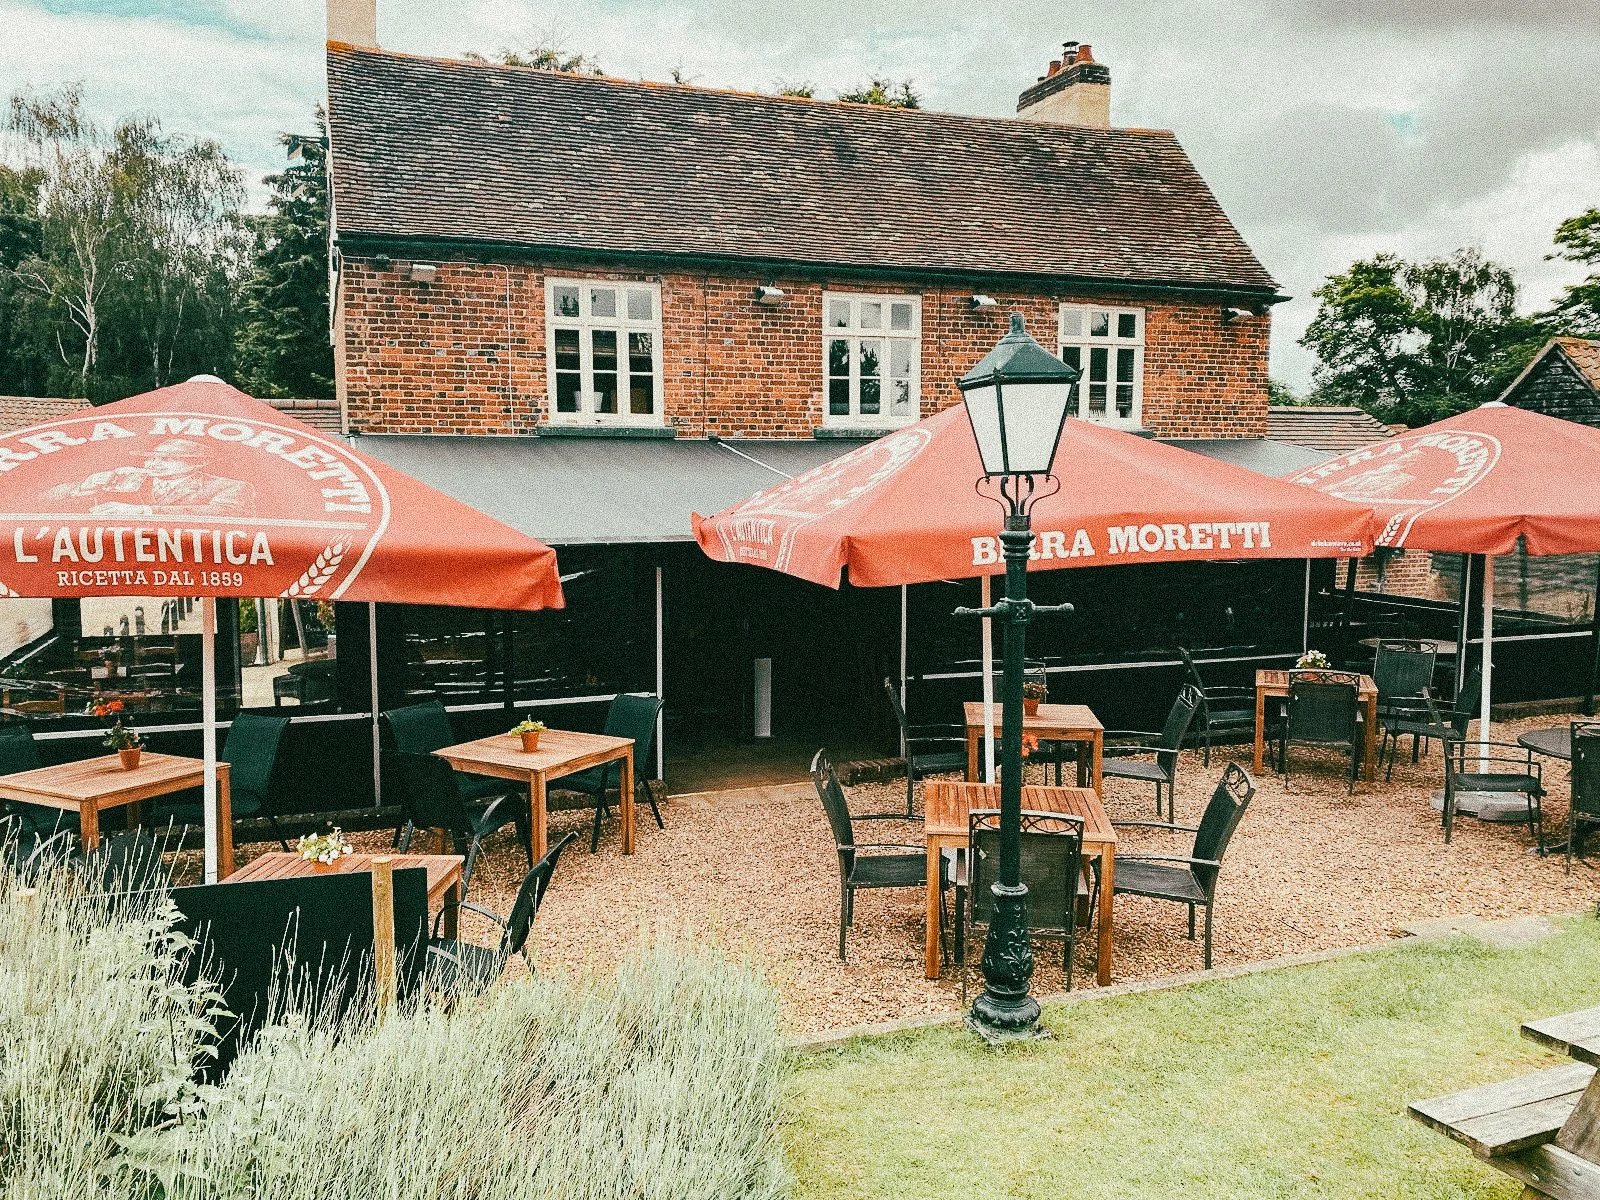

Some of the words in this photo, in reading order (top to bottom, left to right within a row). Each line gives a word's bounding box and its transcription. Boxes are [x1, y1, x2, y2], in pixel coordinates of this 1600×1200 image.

[149, 417, 371, 514] MORETTI
[1408, 434, 1489, 494] MORETTI
[14, 526, 275, 567] L'AUTENTICA
[1107, 521, 1272, 554] MORETTI
[56, 570, 148, 587] RICETTA
[153, 571, 195, 587] DAL
[200, 571, 244, 588] 1859
